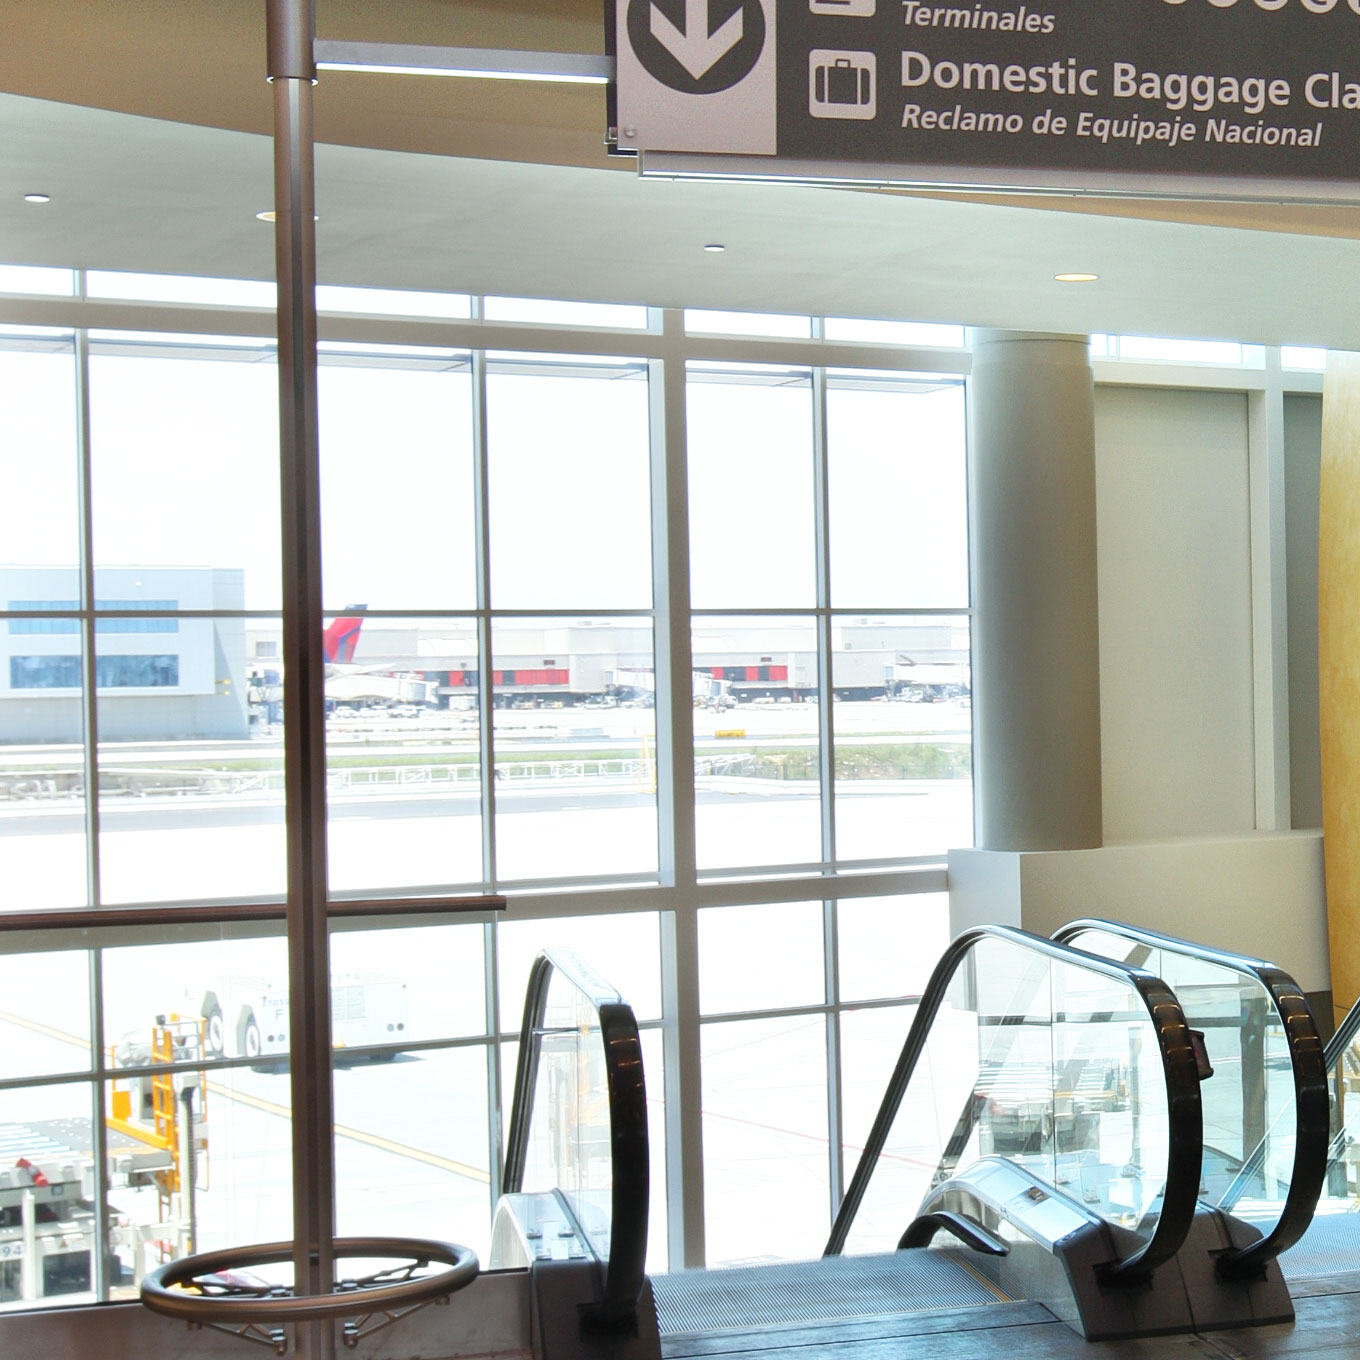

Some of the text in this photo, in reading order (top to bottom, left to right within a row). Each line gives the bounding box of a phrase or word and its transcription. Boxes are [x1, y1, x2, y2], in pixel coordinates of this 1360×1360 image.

[902, 0, 1055, 33] Terminales
[901, 50, 1098, 96] Domestic
[1113, 62, 1291, 114] Baggage
[901, 104, 1323, 147] Reclamo de Equipaje Nacional
